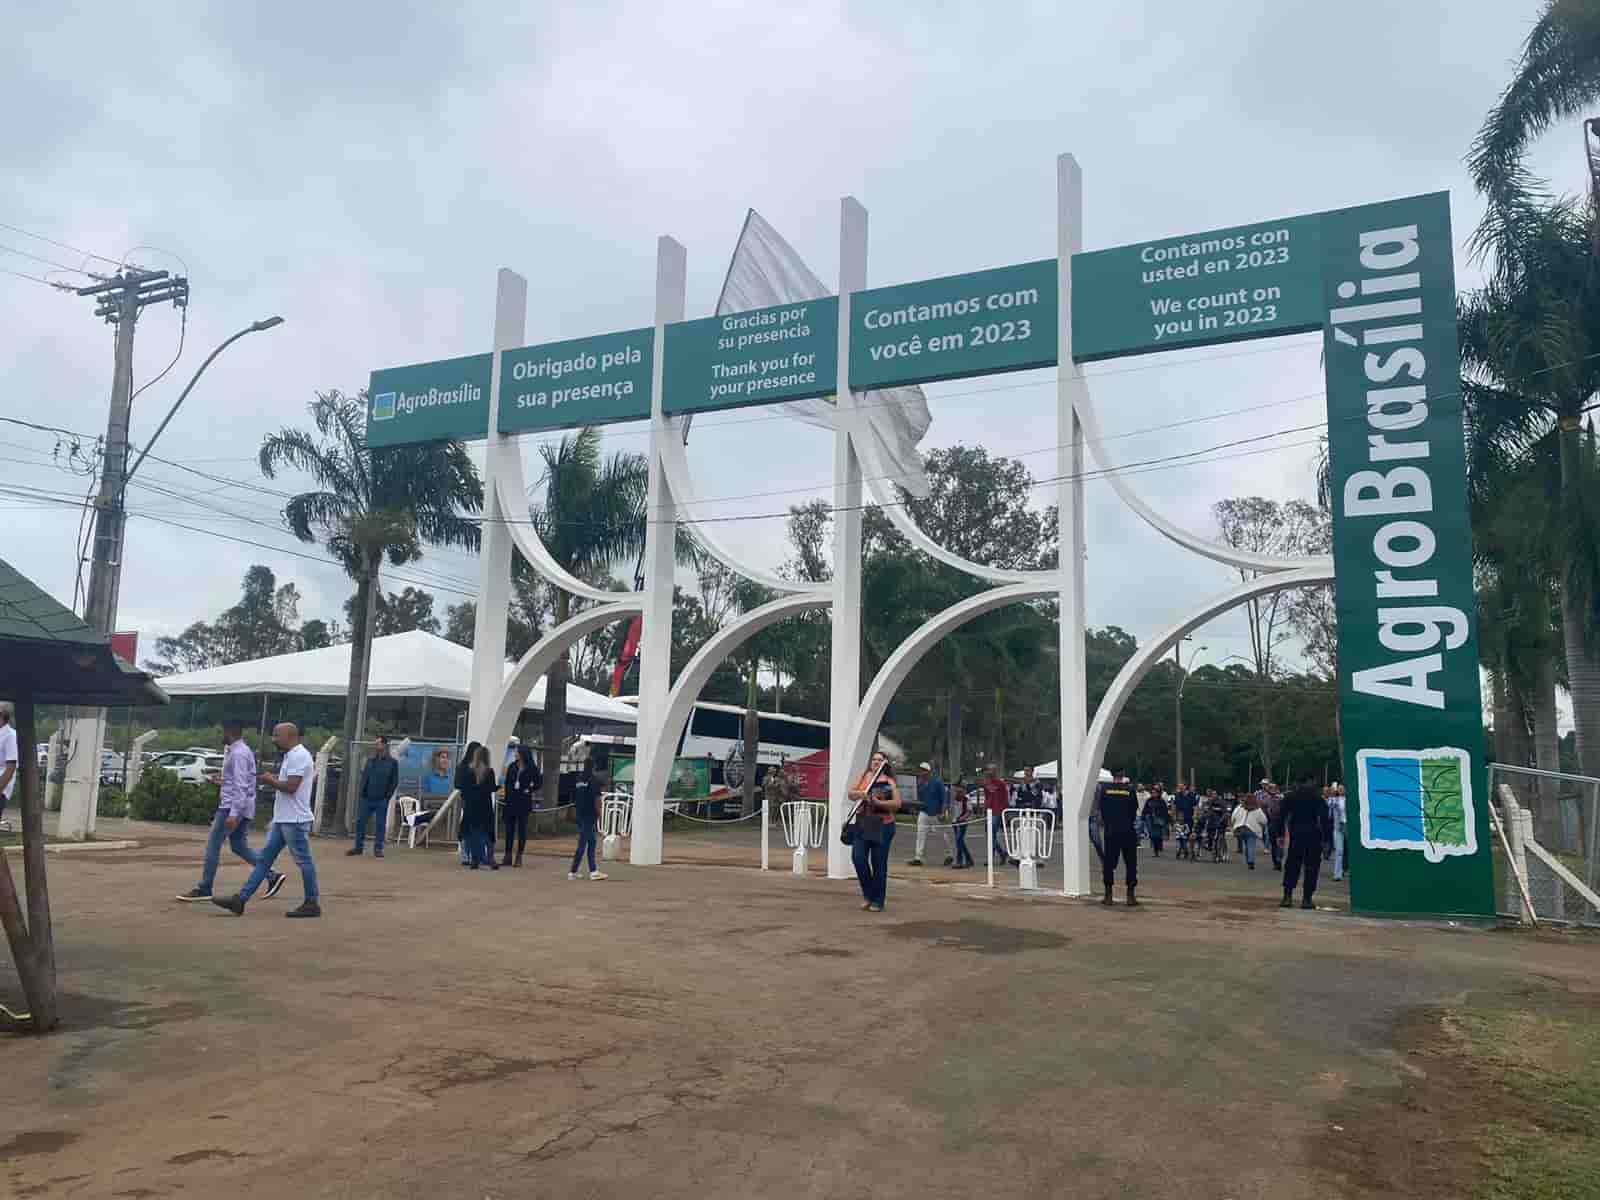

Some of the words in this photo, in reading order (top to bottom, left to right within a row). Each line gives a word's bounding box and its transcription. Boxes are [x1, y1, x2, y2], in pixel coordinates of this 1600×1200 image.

[1141, 236, 1245, 264] Contamos
[1251, 230, 1290, 247] con
[1142, 261, 1199, 284] usted
[1204, 259, 1230, 274] en
[1236, 247, 1290, 271] 2023
[864, 297, 981, 329] Contamos
[986, 289, 1038, 310] com
[1150, 298, 1182, 316] We
[1187, 288, 1248, 312] count
[1253, 286, 1281, 302] on
[721, 309, 777, 331] Gracias
[780, 307, 808, 325] por
[1154, 318, 1194, 340] you
[1198, 312, 1219, 331] in
[1223, 305, 1278, 328] 2023
[718, 337, 734, 350] su
[738, 323, 811, 350] presencia
[869, 335, 922, 361] você
[927, 334, 964, 352] em
[970, 319, 1032, 346] 2023
[512, 352, 597, 381] Obrigado
[602, 347, 642, 373] pela
[710, 360, 757, 378] Thank
[761, 358, 790, 375] you
[792, 352, 816, 367] for
[396, 383, 481, 414] AgroBrasília
[516, 390, 547, 409] sua
[551, 382, 634, 409] presença
[710, 382, 746, 399] your
[746, 373, 816, 395] presence
[1330, 223, 1469, 709] AgroBrasília
